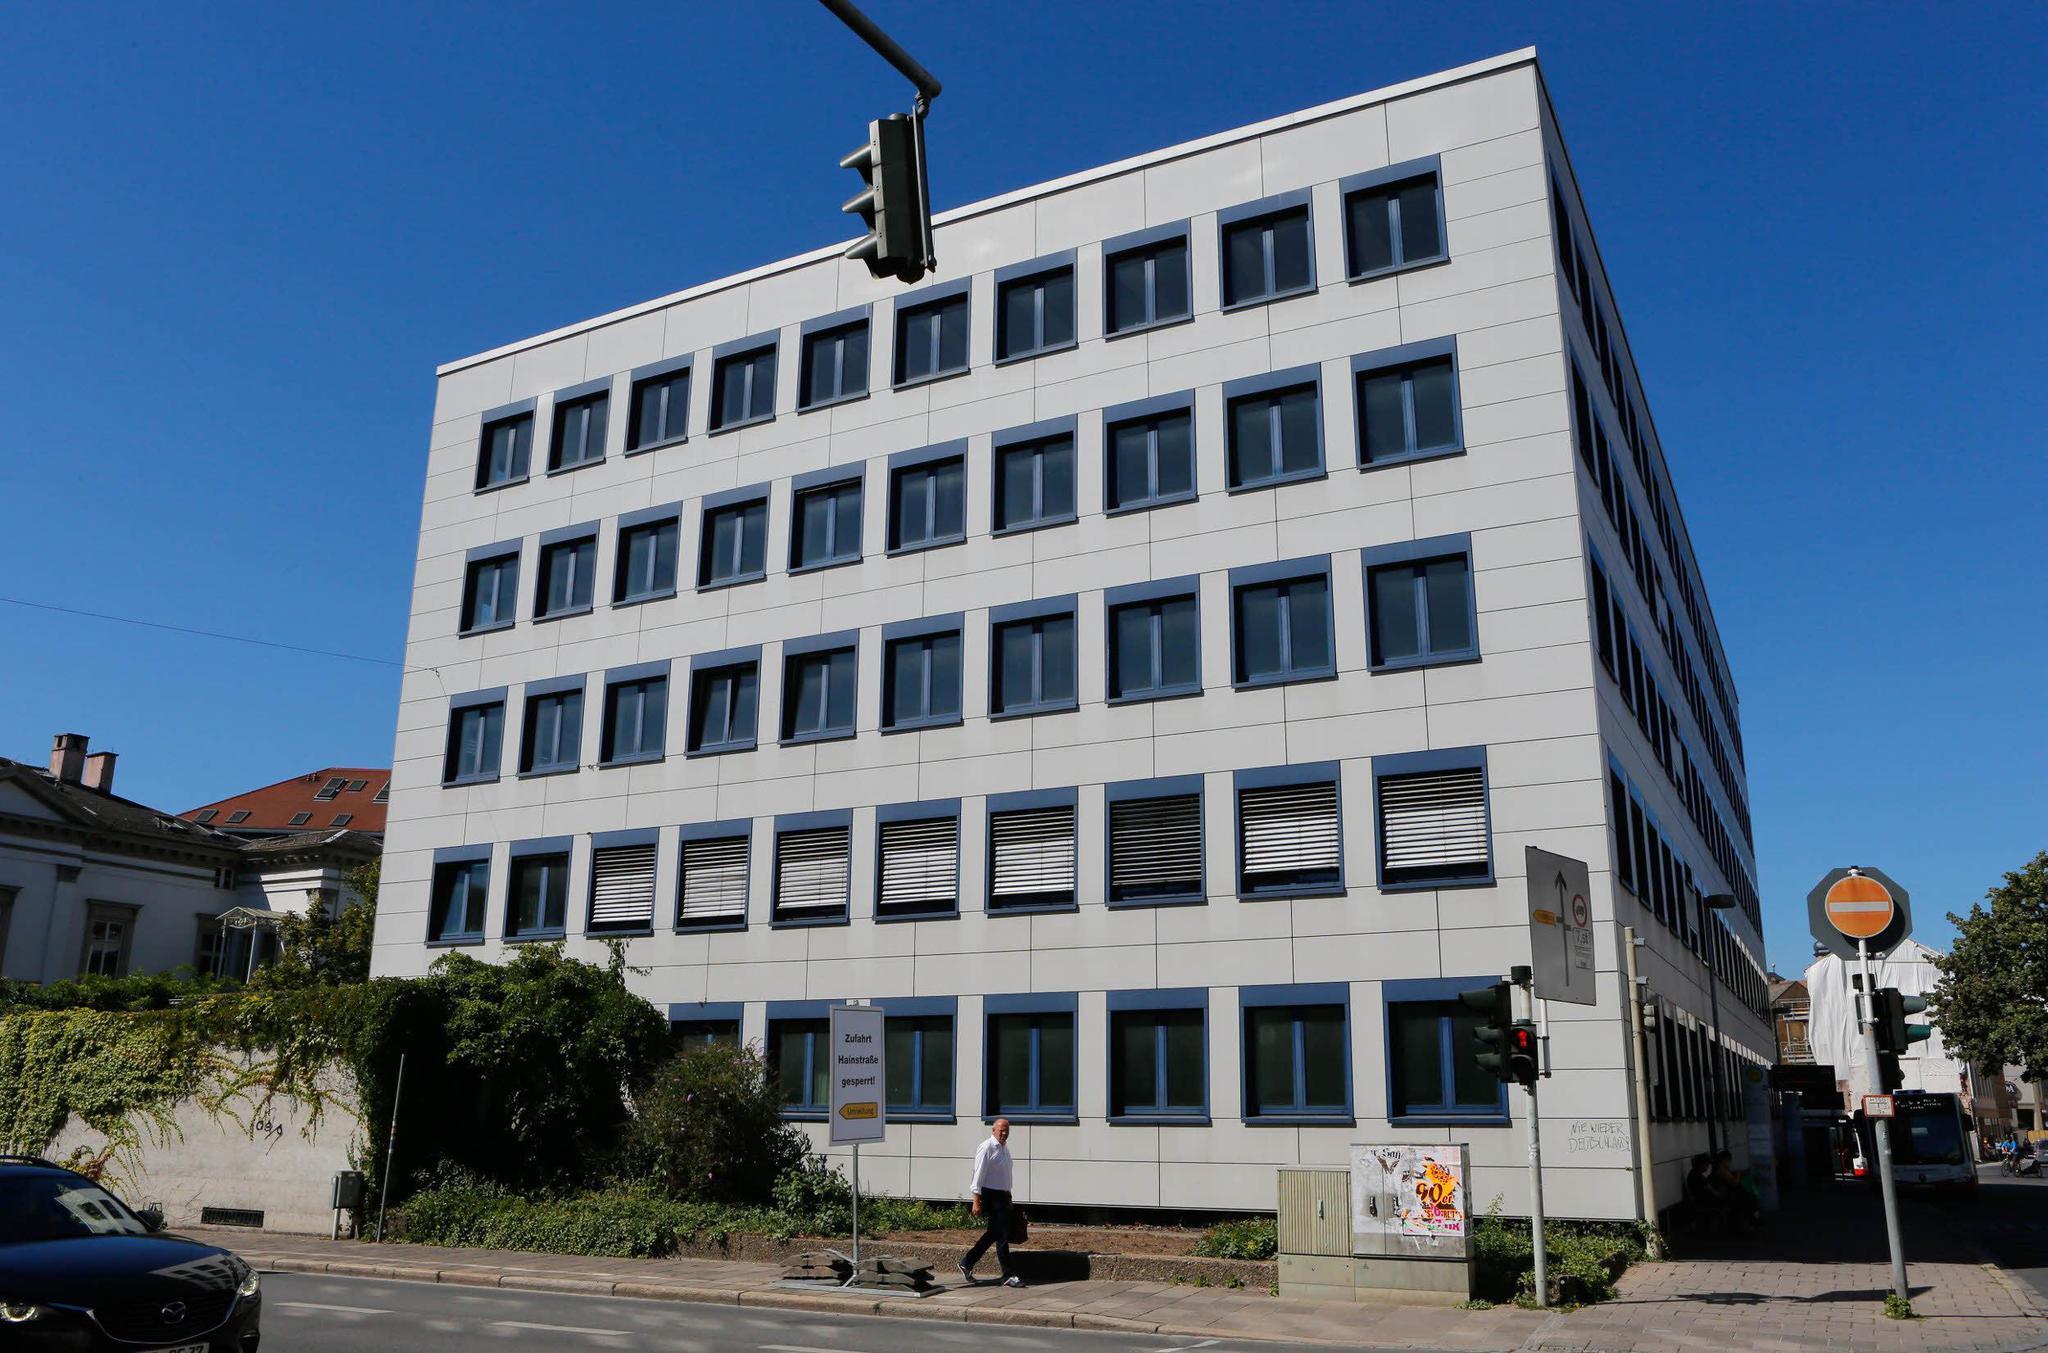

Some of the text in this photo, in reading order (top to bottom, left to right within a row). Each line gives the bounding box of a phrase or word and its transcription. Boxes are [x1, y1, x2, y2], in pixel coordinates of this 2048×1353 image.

[845, 1034, 872, 1043] Zufahrt
[838, 1055, 879, 1065] Hainstraße
[841, 1076, 876, 1088] gesperrt!
